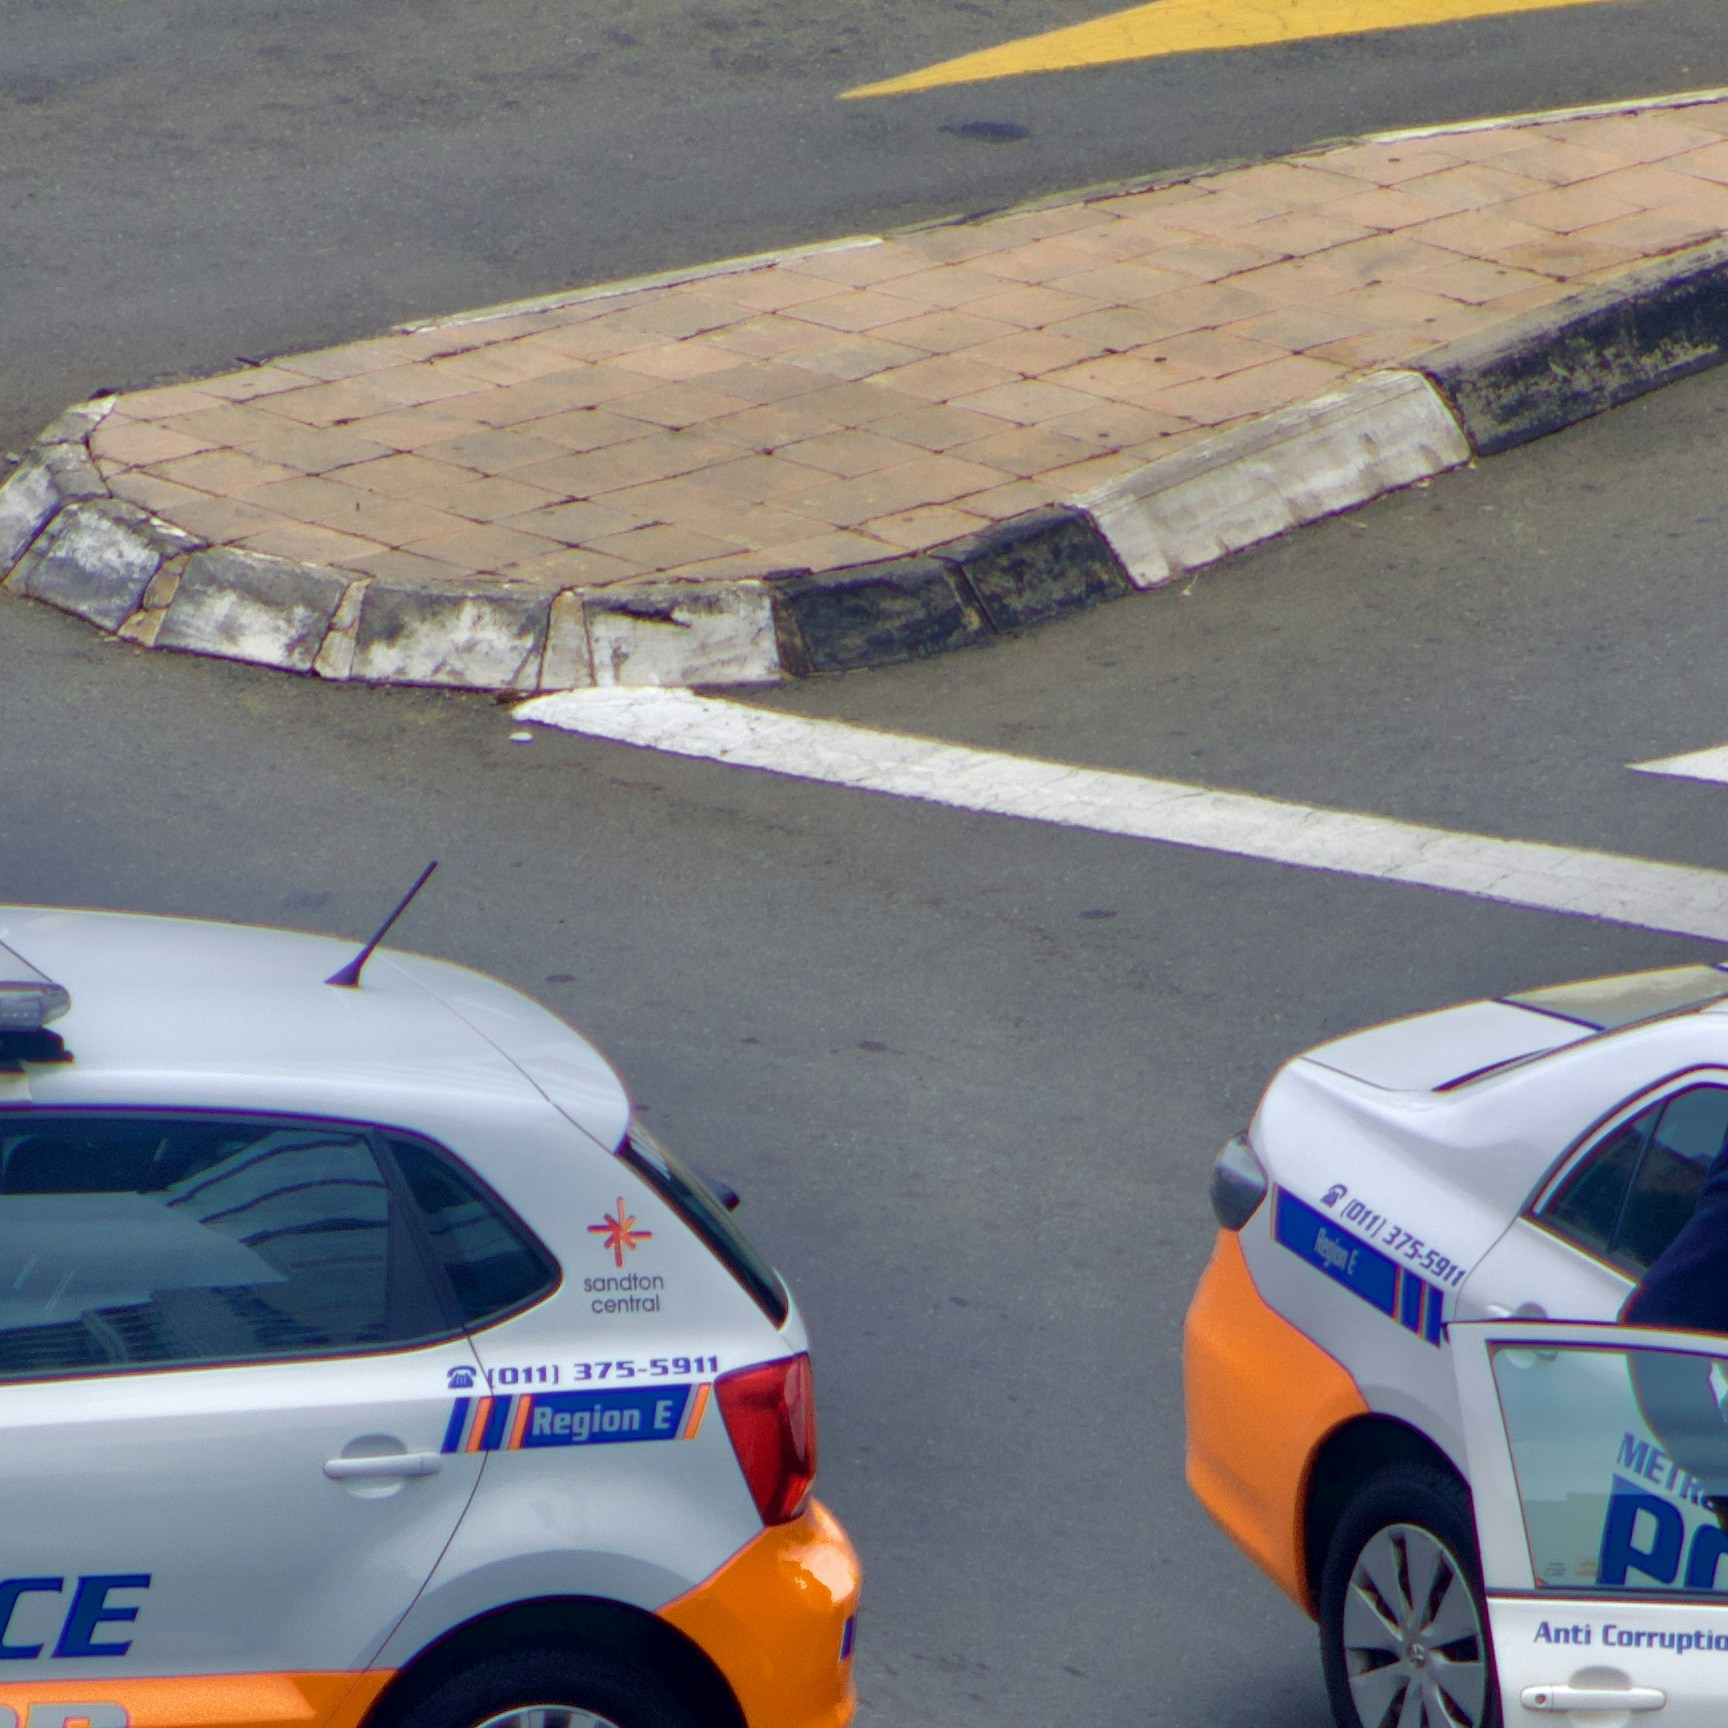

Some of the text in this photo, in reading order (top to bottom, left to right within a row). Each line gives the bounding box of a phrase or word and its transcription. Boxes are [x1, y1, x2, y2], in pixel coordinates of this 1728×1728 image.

[1340, 1199, 1466, 1287] (011) 375-5911
[583, 1273, 665, 1293] sandton
[591, 1294, 660, 1314] central
[487, 1356, 719, 1389] (011) 375-5911
[532, 1400, 673, 1438] Region E
[1533, 1621, 1592, 1645] Anti
